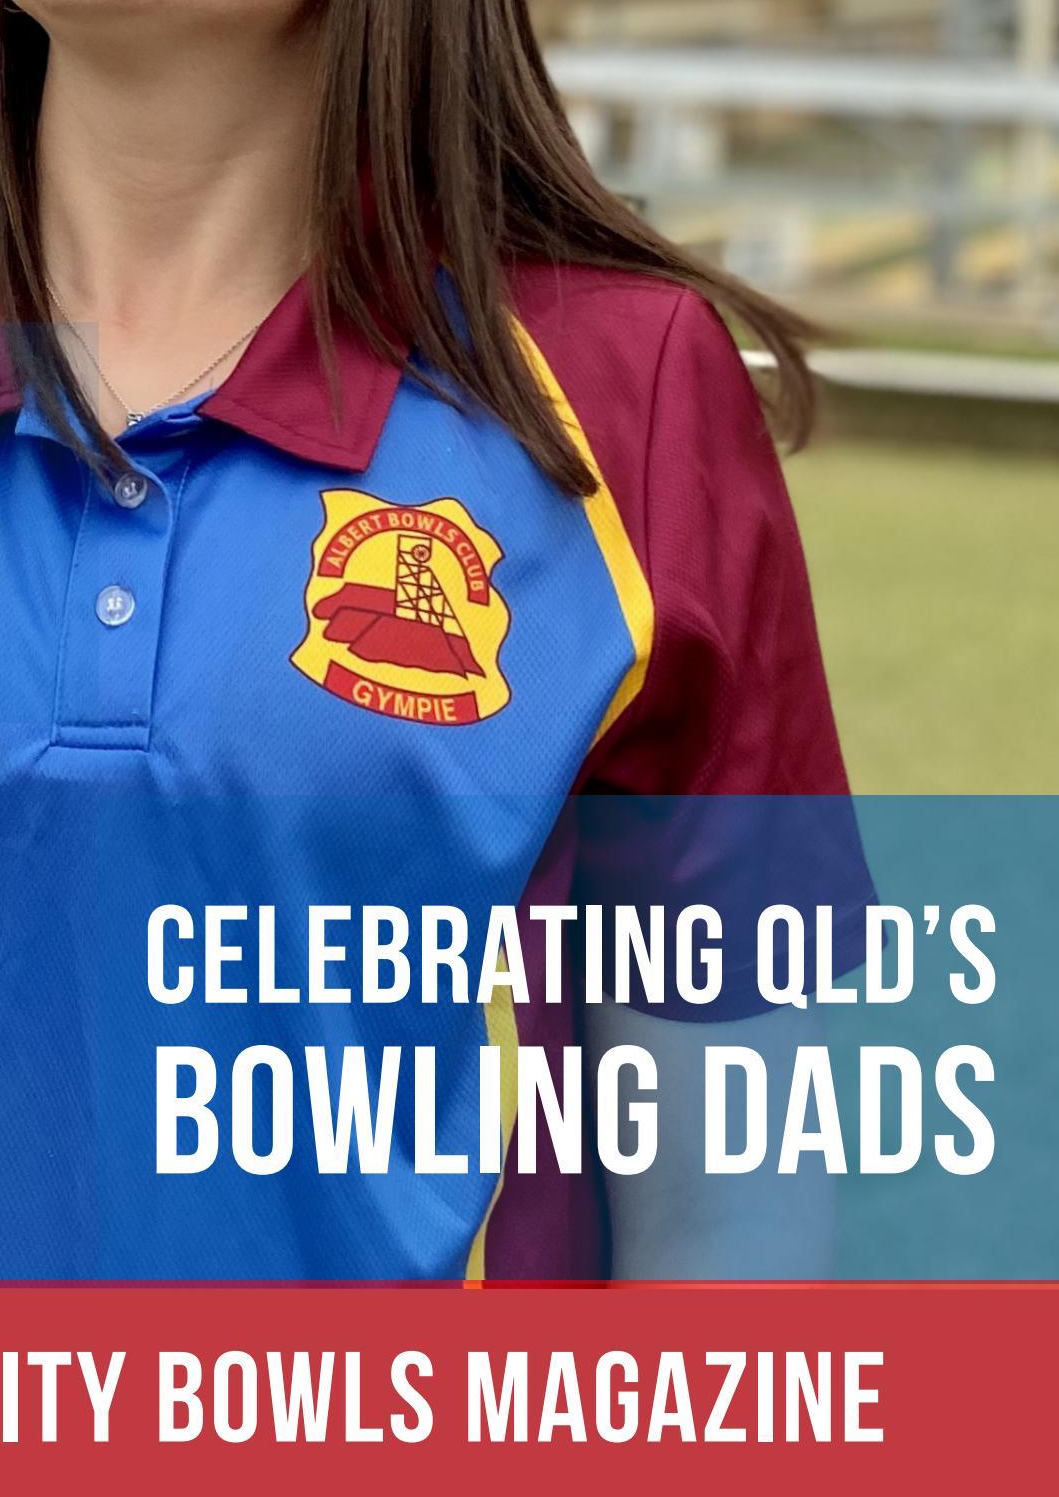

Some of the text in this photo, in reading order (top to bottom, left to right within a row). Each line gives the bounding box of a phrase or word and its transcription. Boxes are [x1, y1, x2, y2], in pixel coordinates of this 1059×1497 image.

[326, 512, 485, 592] ALBERT BOWLS CLUB
[352, 680, 458, 722] GYMPIE
